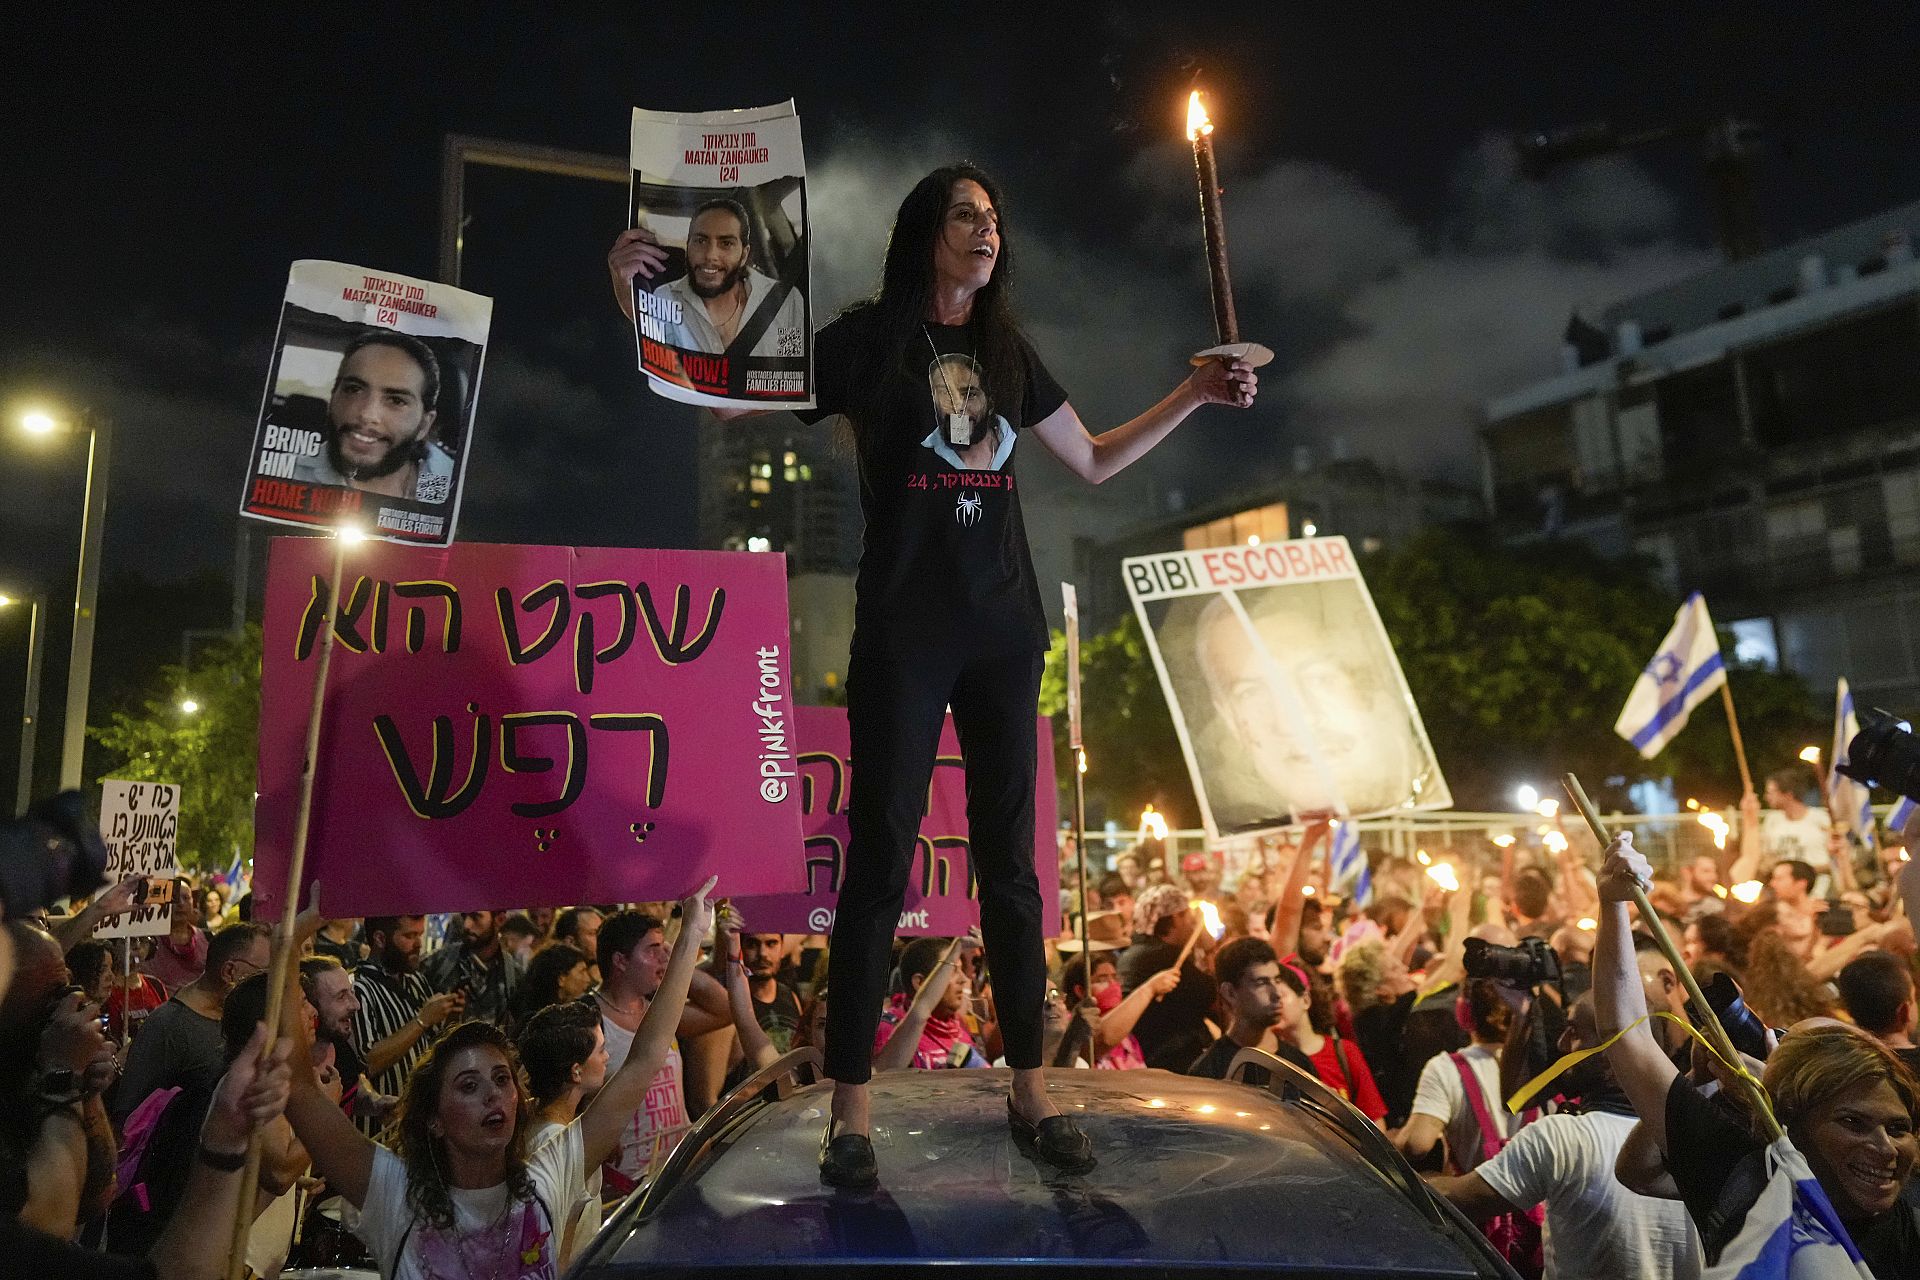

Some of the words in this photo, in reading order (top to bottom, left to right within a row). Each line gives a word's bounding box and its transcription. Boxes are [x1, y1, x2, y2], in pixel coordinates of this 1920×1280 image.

[741, 132, 757, 149] מתן
[684, 150, 718, 165] MATAN
[720, 148, 769, 165] ZANGAUKER
[719, 166, 739, 183] (24)
[342, 287, 378, 305] MATAN
[379, 294, 437, 318] ZANGAUKER
[405, 285, 424, 301] מתן
[638, 289, 684, 325] BRING
[376, 308, 398, 327] (24)
[639, 312, 667, 344] HIM
[641, 337, 680, 374] HOME
[682, 354, 729, 386] NOW!
[746, 379, 779, 392] FAMILIES
[780, 380, 804, 393] FORUM
[263, 424, 322, 457] BRING
[257, 450, 297, 479] HIM
[251, 478, 308, 510] HOME
[907, 473, 928, 491] 24
[377, 515, 413, 533] FAMILIES
[414, 521, 443, 536] FORUM
[1128, 556, 1199, 596] BIBI
[1202, 541, 1352, 586] ESCOBAR
[294, 574, 463, 661] הוא
[495, 579, 726, 694] שקט
